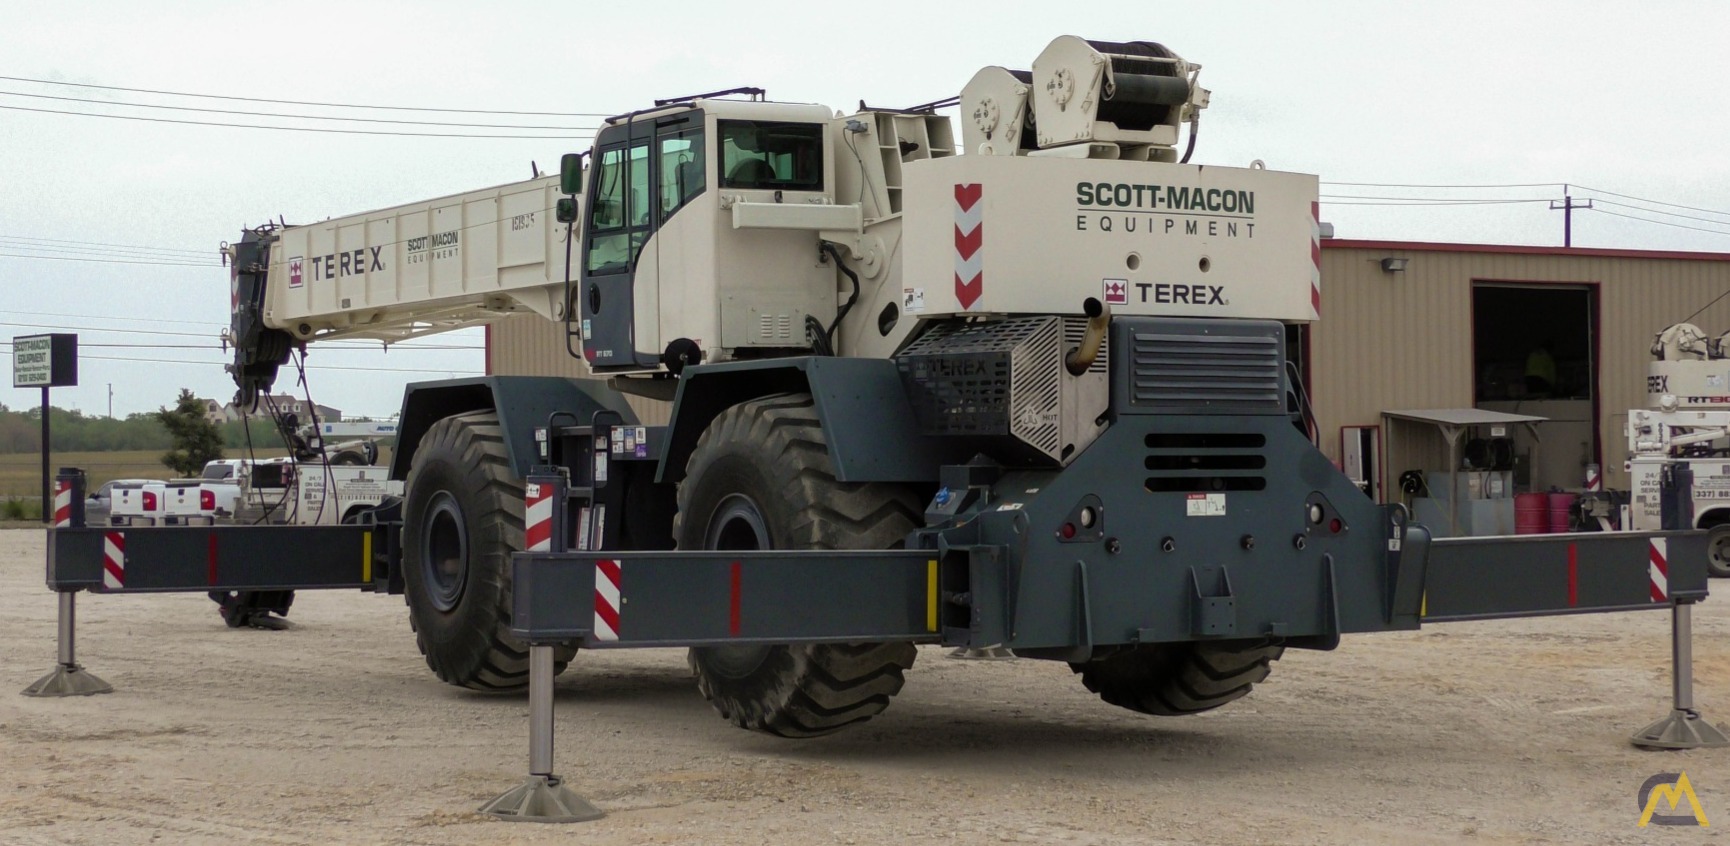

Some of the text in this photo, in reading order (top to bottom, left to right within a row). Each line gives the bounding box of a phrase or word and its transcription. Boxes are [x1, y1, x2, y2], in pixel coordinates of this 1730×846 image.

[1076, 181, 1255, 214] SCOTT-MACON
[1076, 215, 1255, 238] EQUIPMENT
[312, 245, 383, 281] TEREX
[407, 247, 459, 264] EQUIPMENT
[1135, 282, 1226, 305] TEREX
